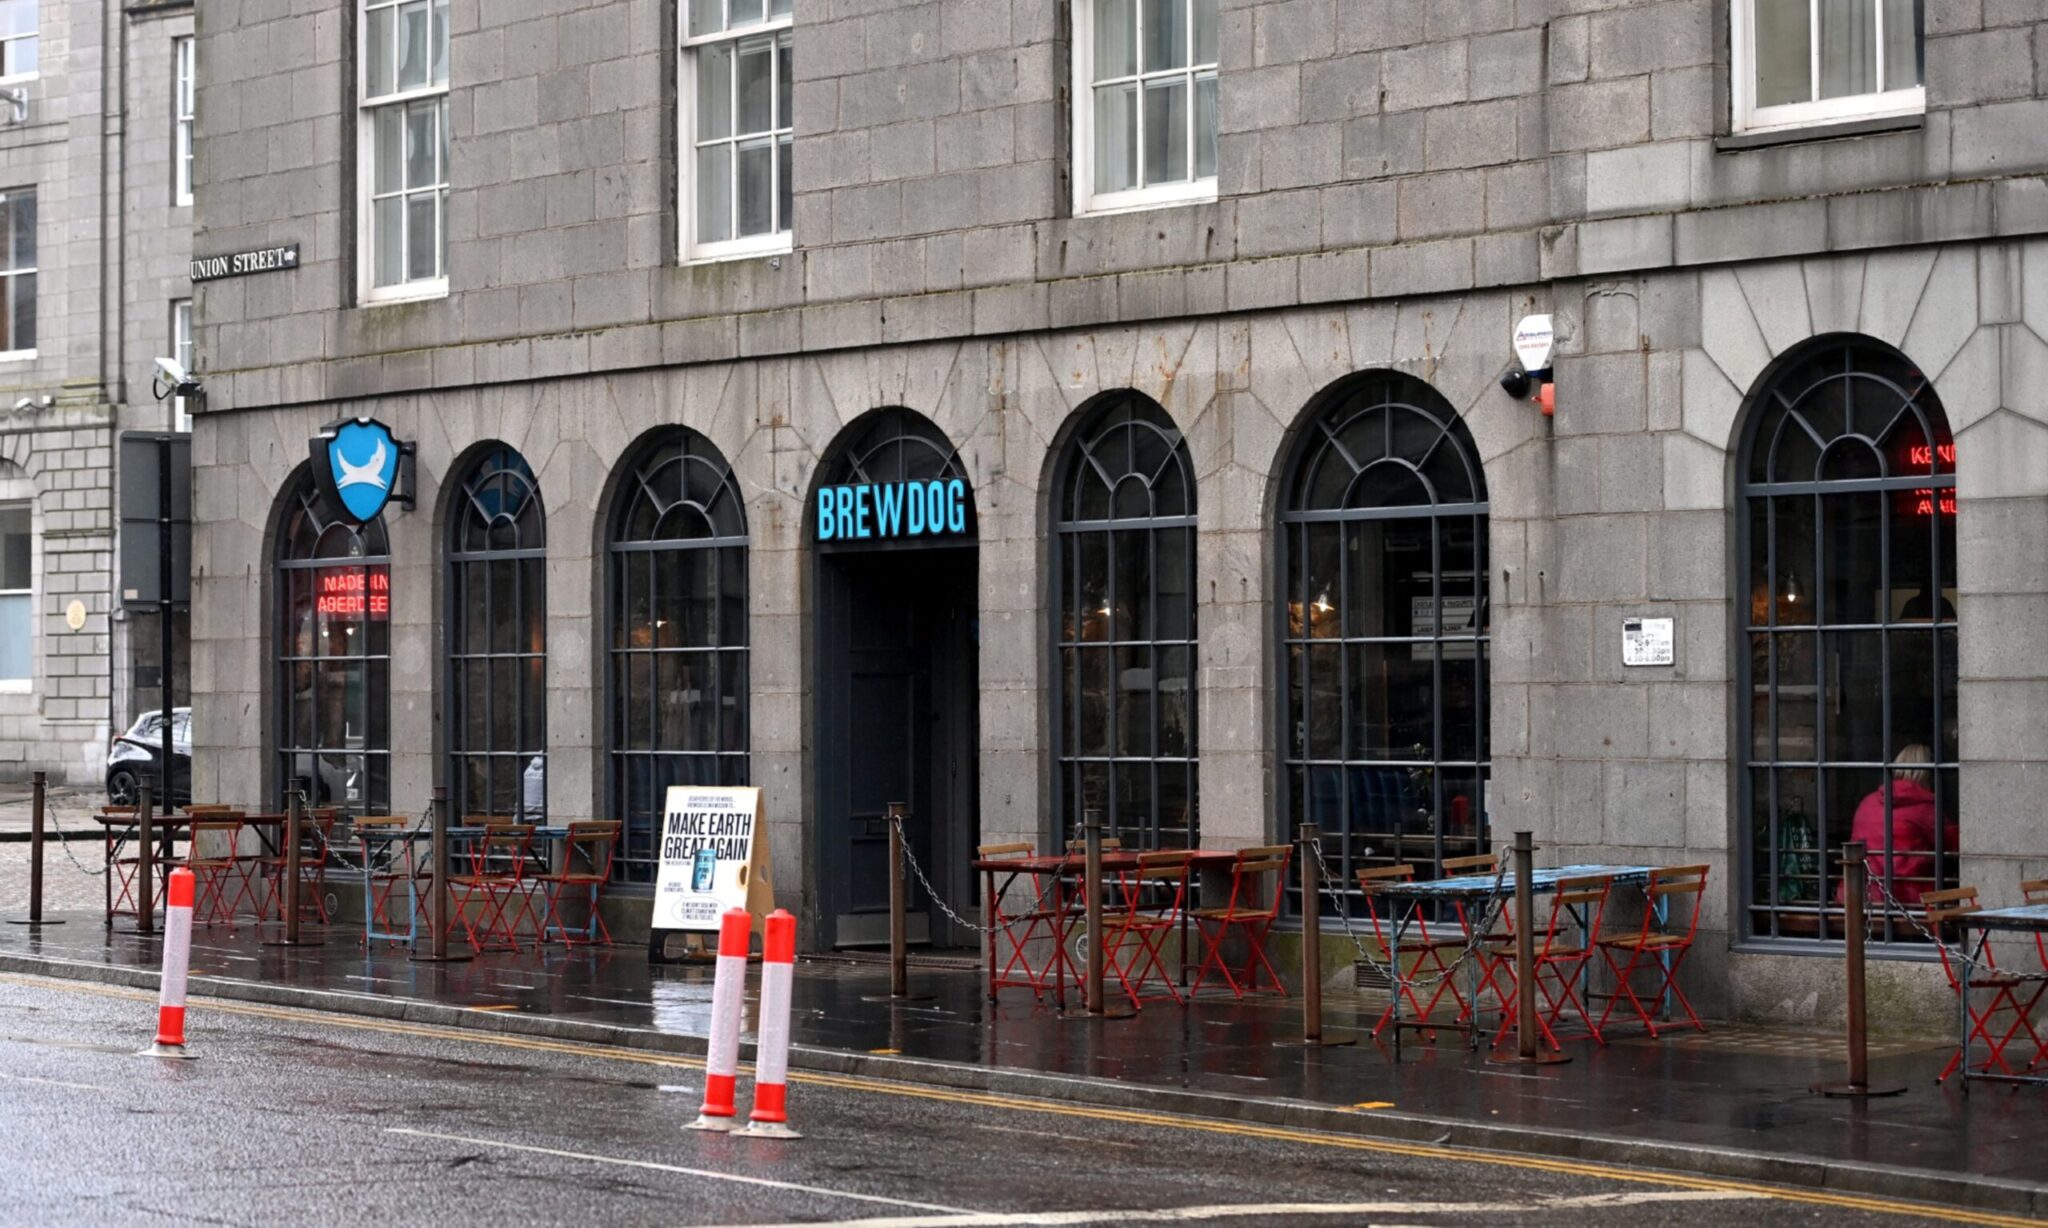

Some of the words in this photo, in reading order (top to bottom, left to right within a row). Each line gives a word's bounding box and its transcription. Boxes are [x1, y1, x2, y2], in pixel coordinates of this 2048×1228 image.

[190, 256, 228, 279] UNION
[233, 247, 285, 273] STREET
[818, 478, 965, 540] BREWDOG
[324, 574, 365, 592] MADE
[374, 574, 389, 590] IN
[667, 812, 707, 836] MAKE
[708, 812, 752, 836] EARTH
[664, 836, 707, 860] GREAT
[708, 837, 749, 861] AGAIN
